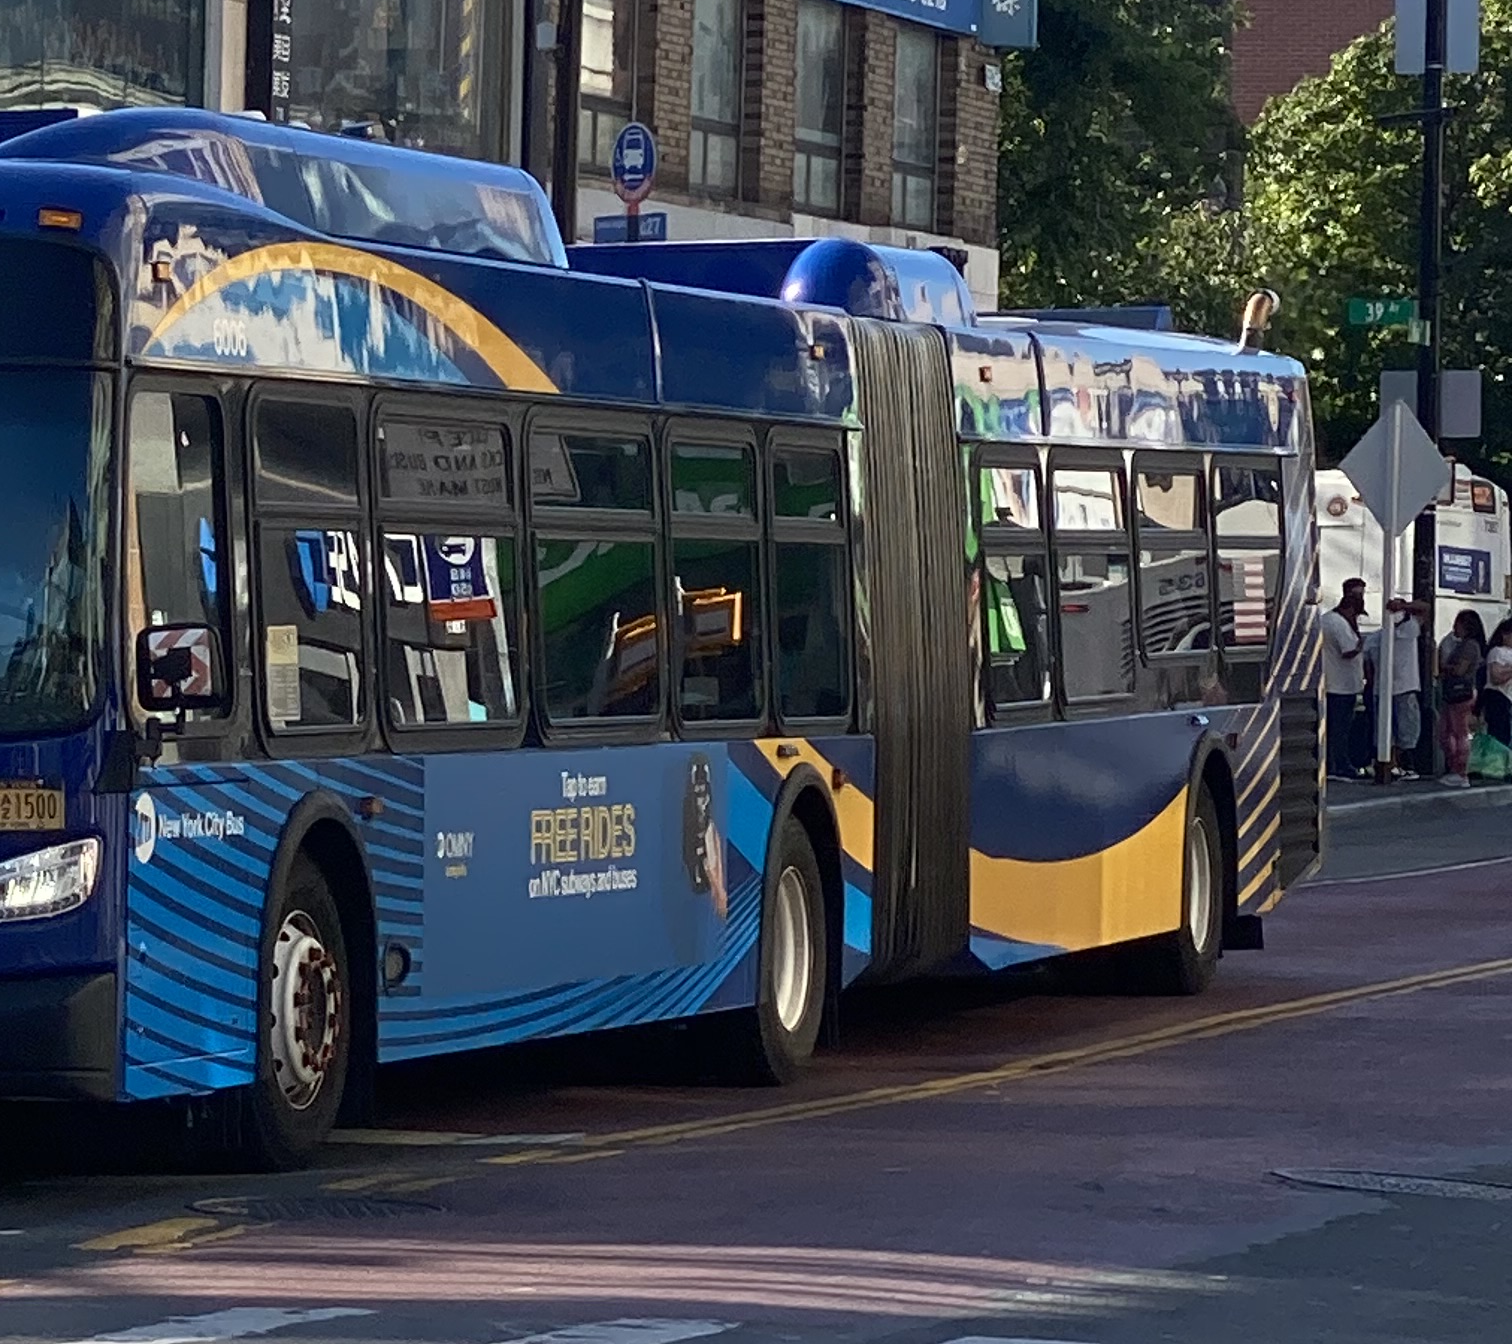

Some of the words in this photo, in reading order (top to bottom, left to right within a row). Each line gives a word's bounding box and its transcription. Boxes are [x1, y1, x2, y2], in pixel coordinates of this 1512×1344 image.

[1365, 302, 1385, 323] 39
[213, 317, 247, 357] 6006
[561, 771, 576, 803] Tap
[577, 772, 587, 797] to
[588, 774, 607, 797] earn
[16, 792, 57, 819] 1500
[158, 813, 181, 839] New
[181, 811, 204, 838] York
[204, 810, 225, 841] City
[226, 810, 245, 836] Bus
[531, 808, 578, 865] FREE
[580, 803, 636, 862] RIDES
[528, 877, 541, 899] on
[541, 869, 560, 897] NYC
[561, 869, 596, 899] subways
[596, 864, 612, 893] and
[612, 865, 638, 890] buses
